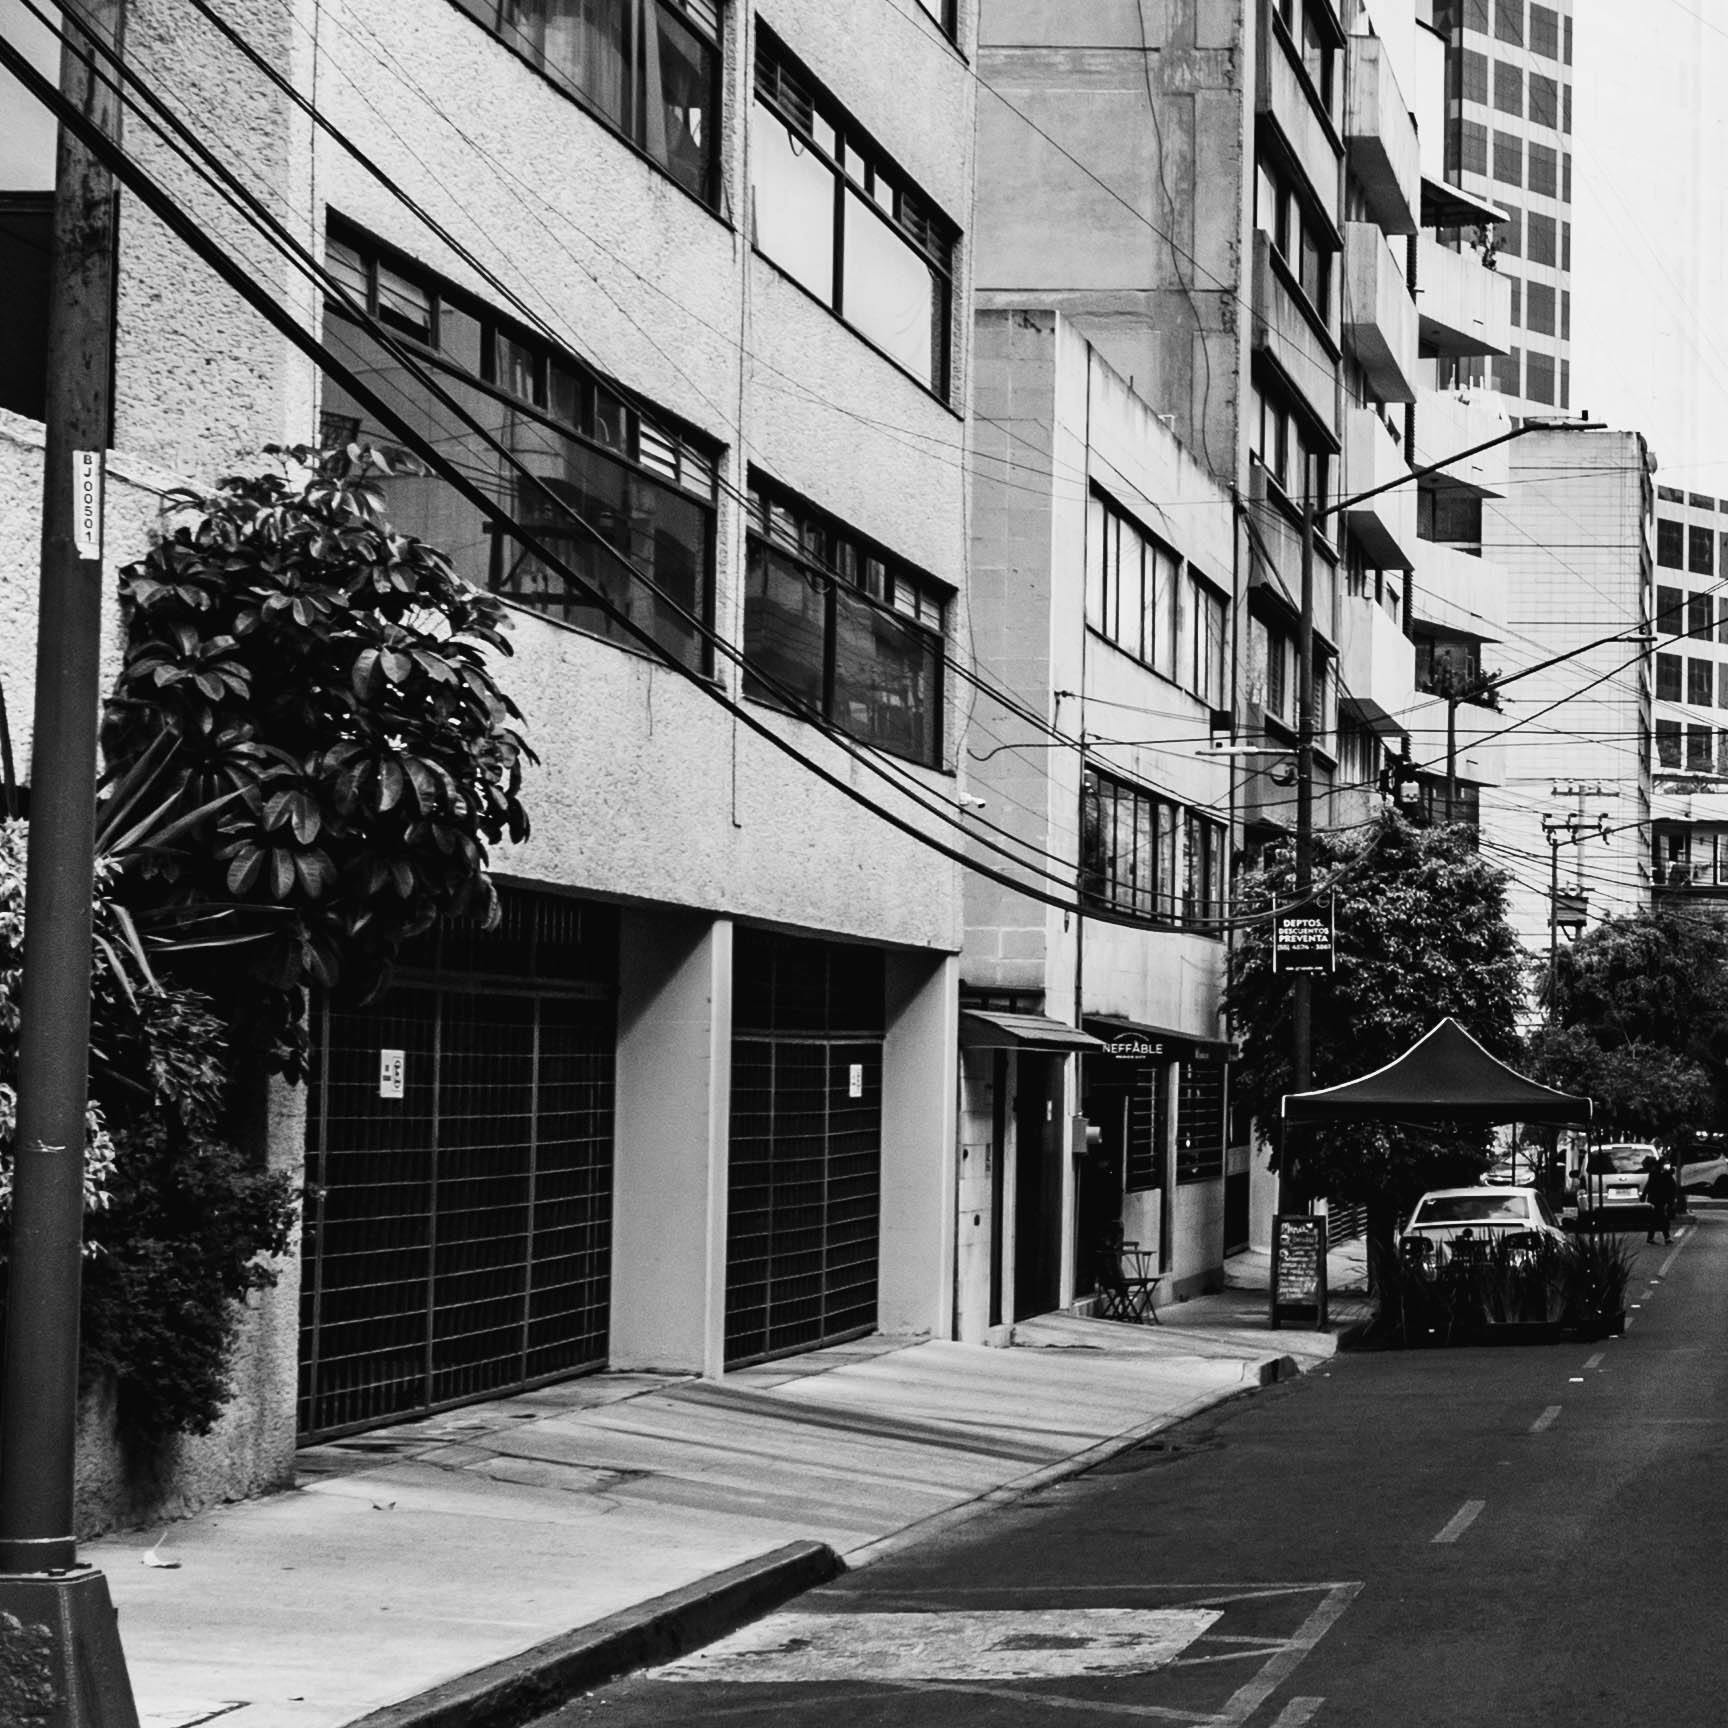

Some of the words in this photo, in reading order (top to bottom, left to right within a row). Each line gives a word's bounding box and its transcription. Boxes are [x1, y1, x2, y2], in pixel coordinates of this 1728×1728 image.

[82, 454, 93, 543] BJ00501
[1278, 927, 1329, 935] DESCUENTOS
[1278, 934, 1328, 943] PREVENTA
